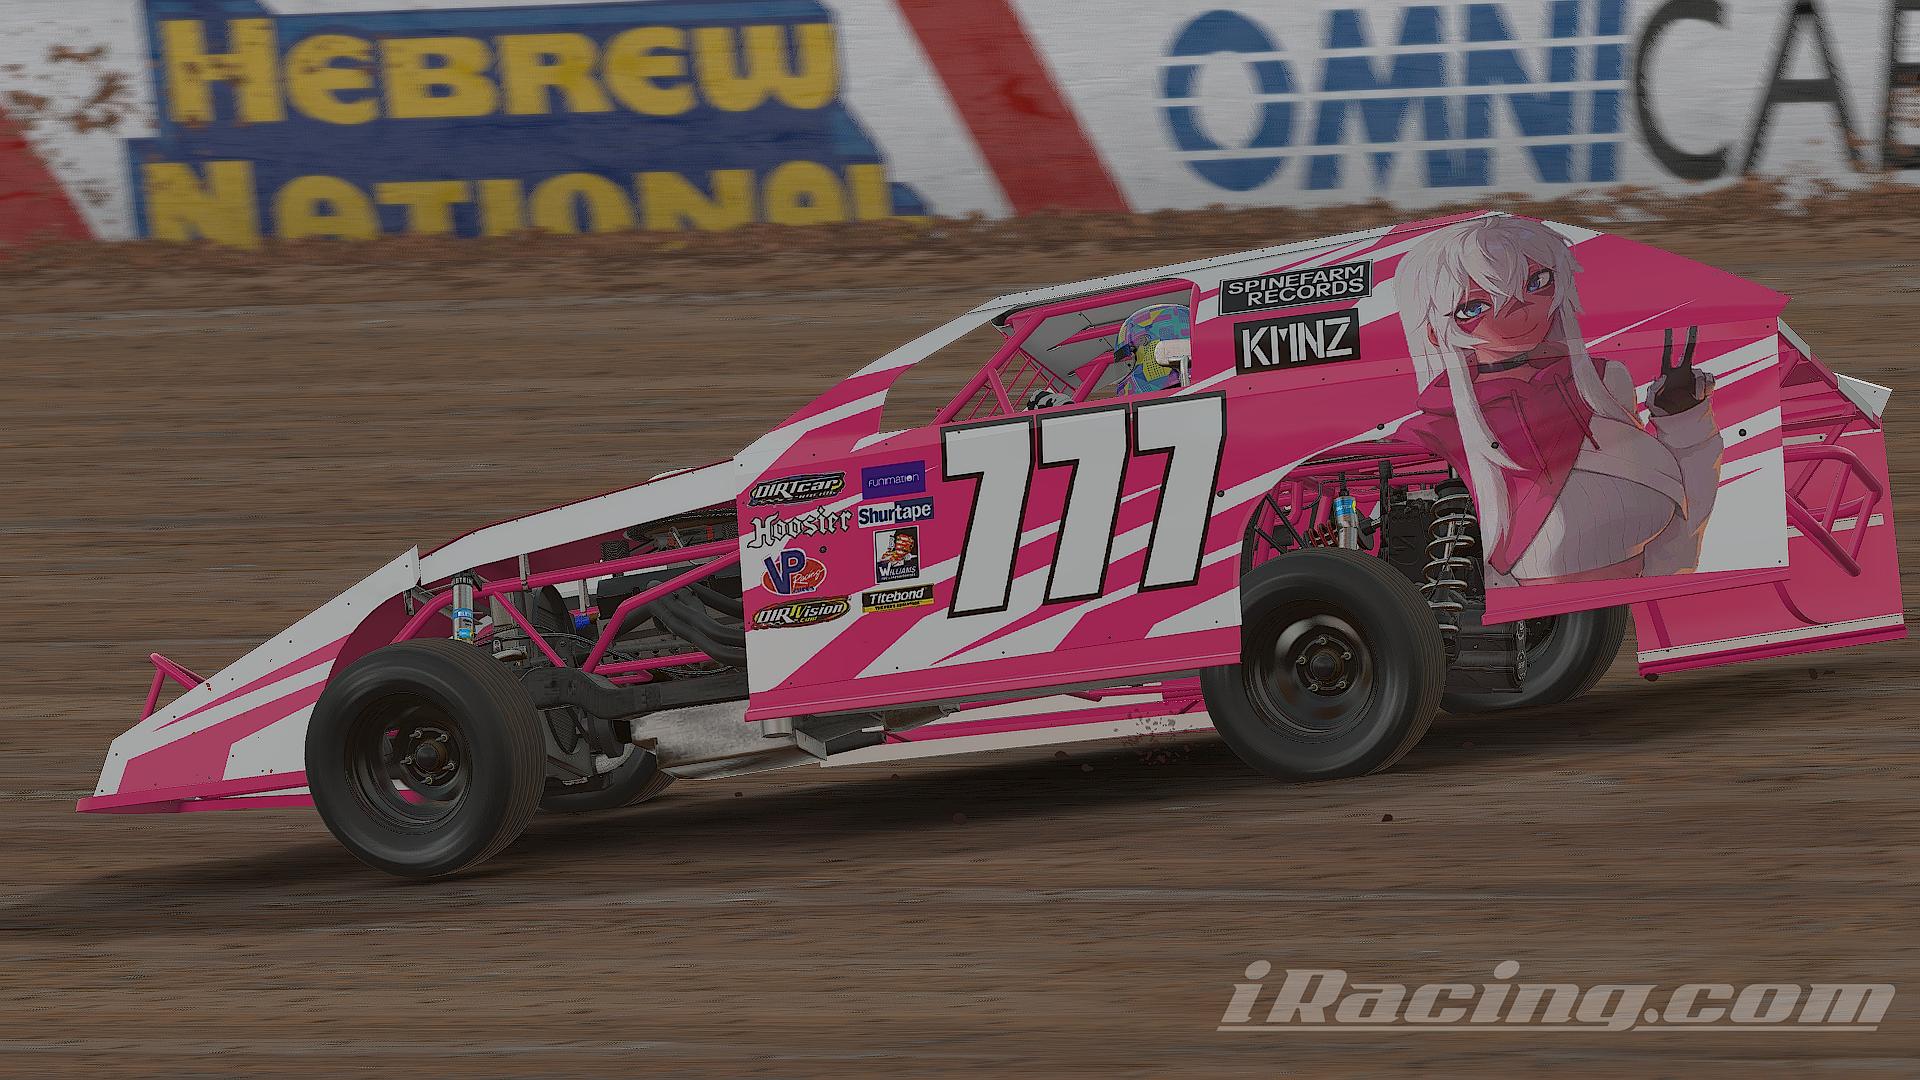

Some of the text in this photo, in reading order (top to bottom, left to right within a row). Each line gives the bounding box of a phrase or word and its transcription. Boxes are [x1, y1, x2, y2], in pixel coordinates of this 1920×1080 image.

[159, 18, 840, 125] HEBREW
[142, 159, 924, 248] NATIONAL
[1228, 264, 1365, 295] SPINEFARM
[1247, 278, 1365, 307] RECORDS
[1242, 316, 1353, 369] KMNZ
[858, 502, 932, 525] Shurtape
[940, 390, 1227, 619] 777
[747, 506, 853, 549] Hoosier
[763, 550, 806, 595] VP
[869, 588, 925, 605] Titebond
